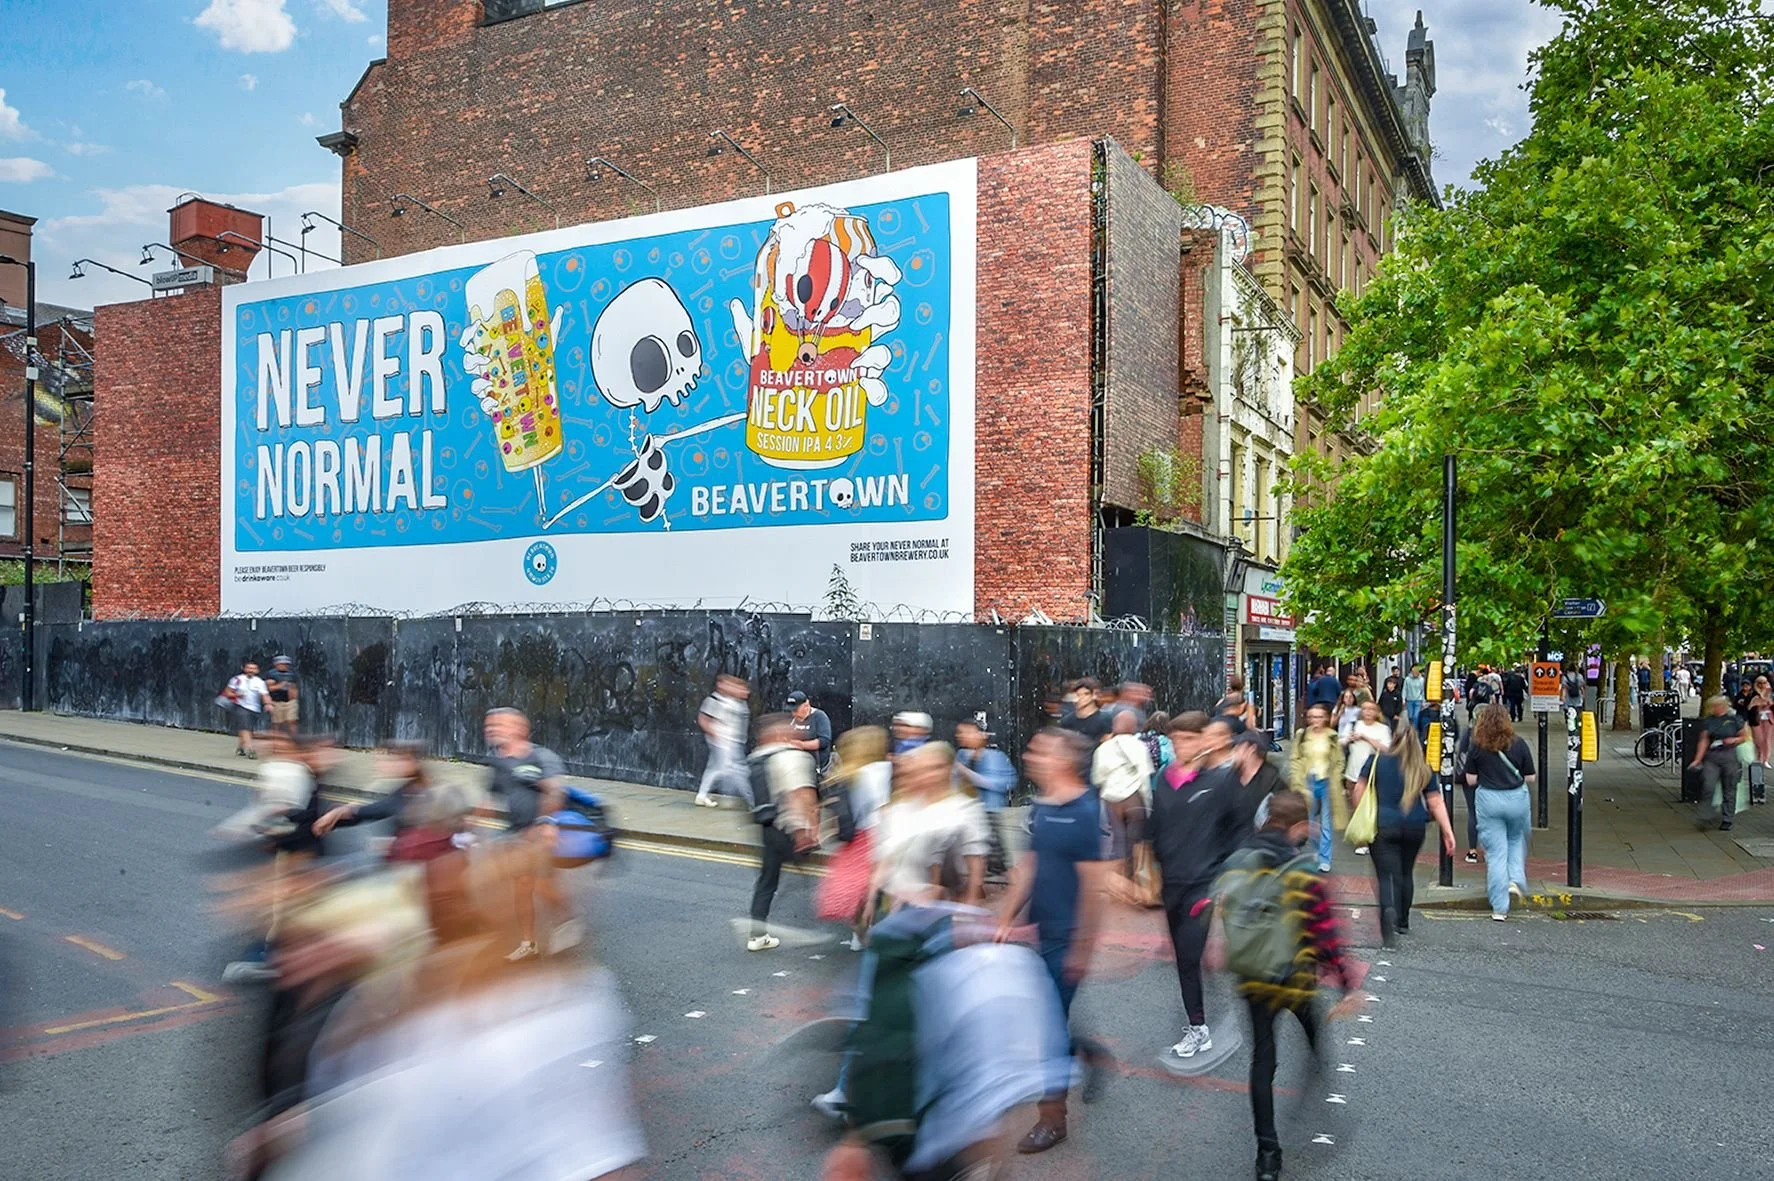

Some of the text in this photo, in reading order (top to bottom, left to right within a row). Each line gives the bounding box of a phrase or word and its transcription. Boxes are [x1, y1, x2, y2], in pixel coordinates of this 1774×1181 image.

[256, 310, 447, 432] NEVER
[760, 368, 858, 386] BEAVERTOWN
[750, 384, 863, 433] NECK OIL
[757, 432, 799, 452] SESSION
[803, 436, 821, 453] IPA
[256, 429, 448, 519] NORMAL
[691, 473, 910, 517] BEAVERTOWN
[850, 538, 949, 552] SHARE YOUR NEVER NORMAL AT
[850, 549, 949, 562] BEAVERTOWNBREWERY.CO.UK
